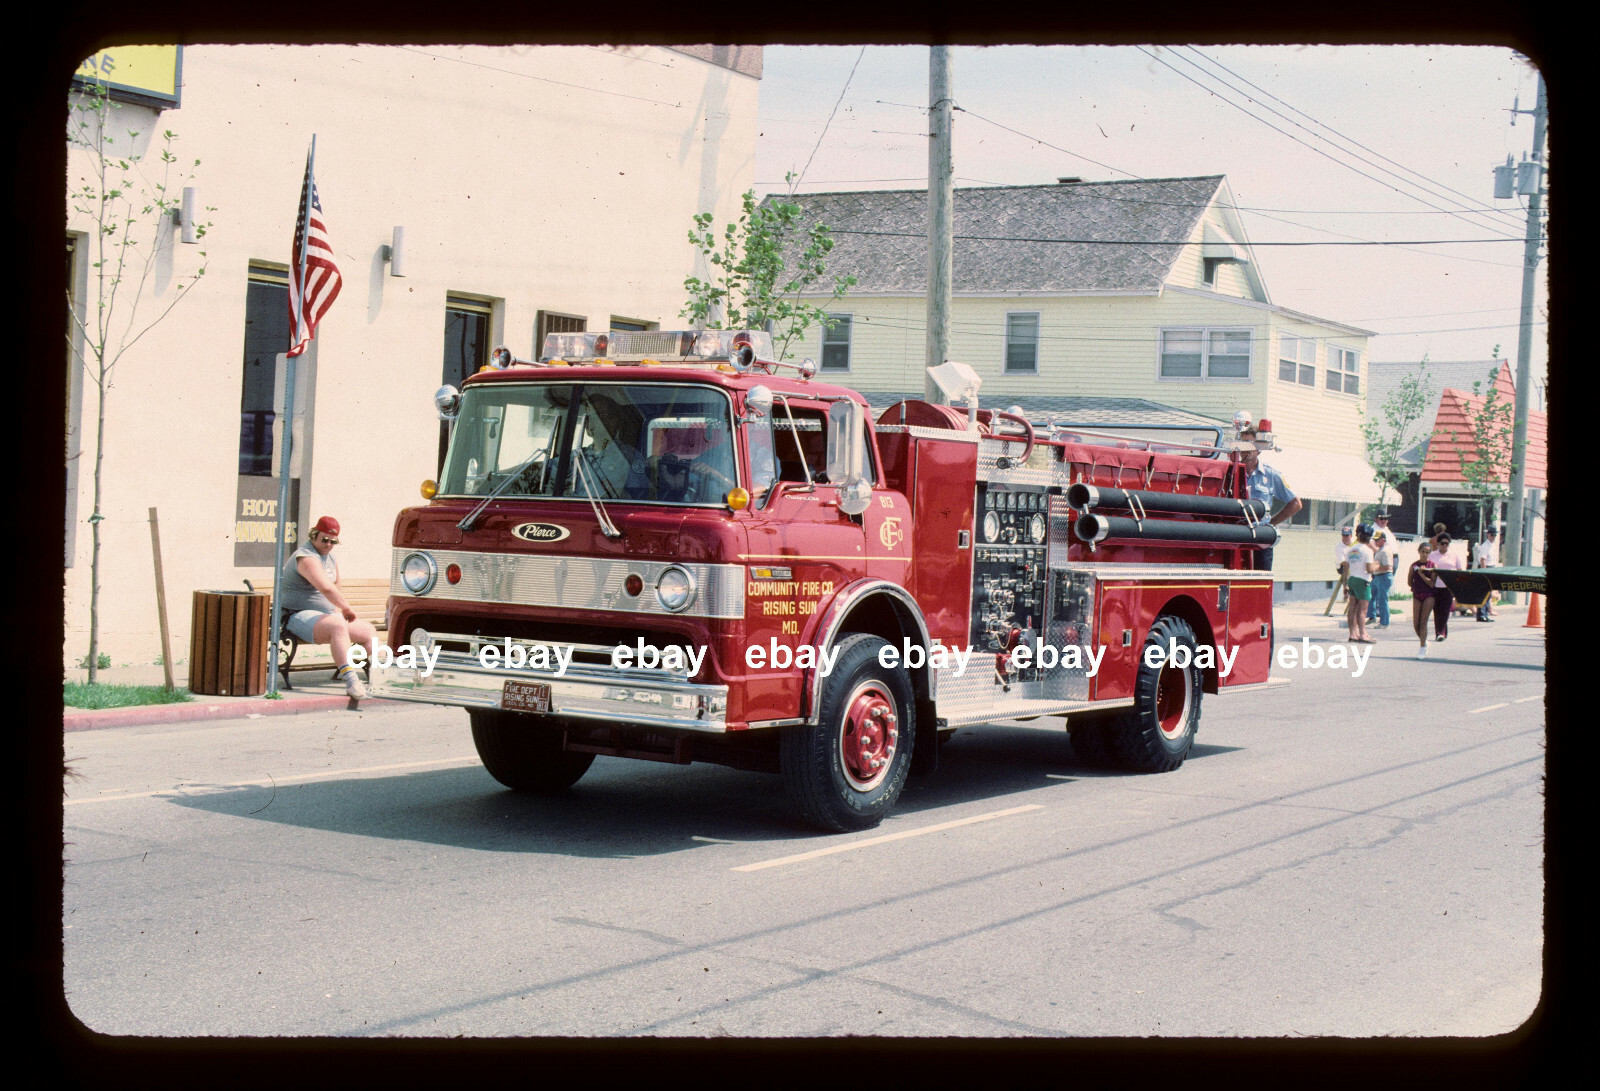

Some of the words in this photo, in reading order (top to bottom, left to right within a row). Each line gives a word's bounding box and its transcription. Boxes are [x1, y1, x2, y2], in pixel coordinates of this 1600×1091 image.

[242, 499, 278, 517] HOT
[235, 520, 297, 543] ANDWICES
[523, 524, 556, 538] Pierce
[748, 581, 800, 597] COMMUNITY
[802, 581, 820, 596] FIRE
[821, 581, 835, 595] CO.
[763, 601, 796, 615] RISING
[799, 601, 817, 615] SUN
[782, 620, 800, 635] MD.
[504, 692, 525, 702] RISING
